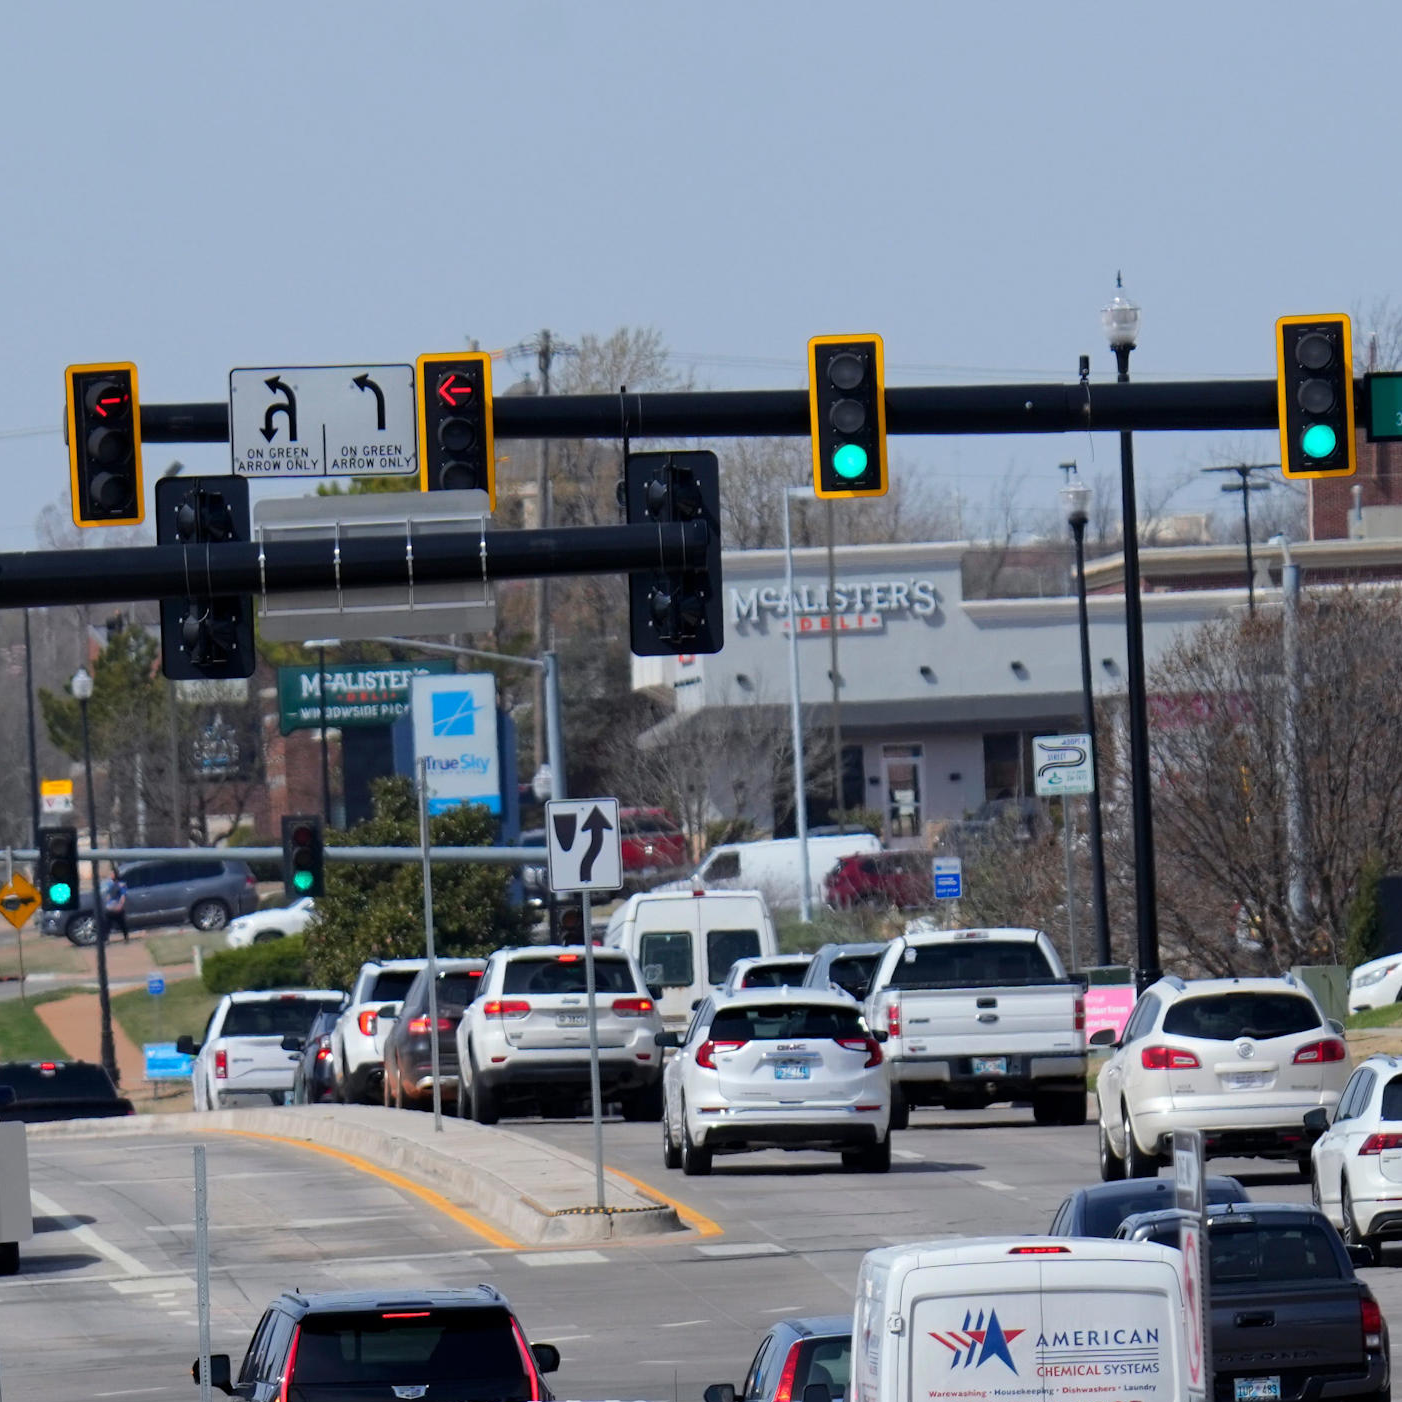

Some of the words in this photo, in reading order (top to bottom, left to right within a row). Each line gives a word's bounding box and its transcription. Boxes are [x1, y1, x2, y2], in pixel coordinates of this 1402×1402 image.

[247, 448, 263, 459] ON
[269, 447, 309, 458] GREEN
[341, 446, 357, 457] ON
[363, 445, 402, 457] GREEN
[238, 460, 282, 472] ARROW
[286, 459, 319, 471] ONLY
[331, 457, 375, 470] ARROW
[380, 456, 412, 468] ONLY
[800, 616, 864, 632] DELI
[347, 691, 388, 702] DELI
[777, 1043, 807, 1051] GMC
[1036, 1328, 1158, 1347] AMERICAN
[1036, 1364, 1102, 1378] CHEMICAL
[1104, 1362, 1160, 1376] SYSTEMS
[928, 1389, 987, 1399] Warewashing
[994, 1387, 1055, 1397] Housekeeping
[1062, 1385, 1116, 1395] Dishwashers
[1124, 1384, 1157, 1393] Laundry
